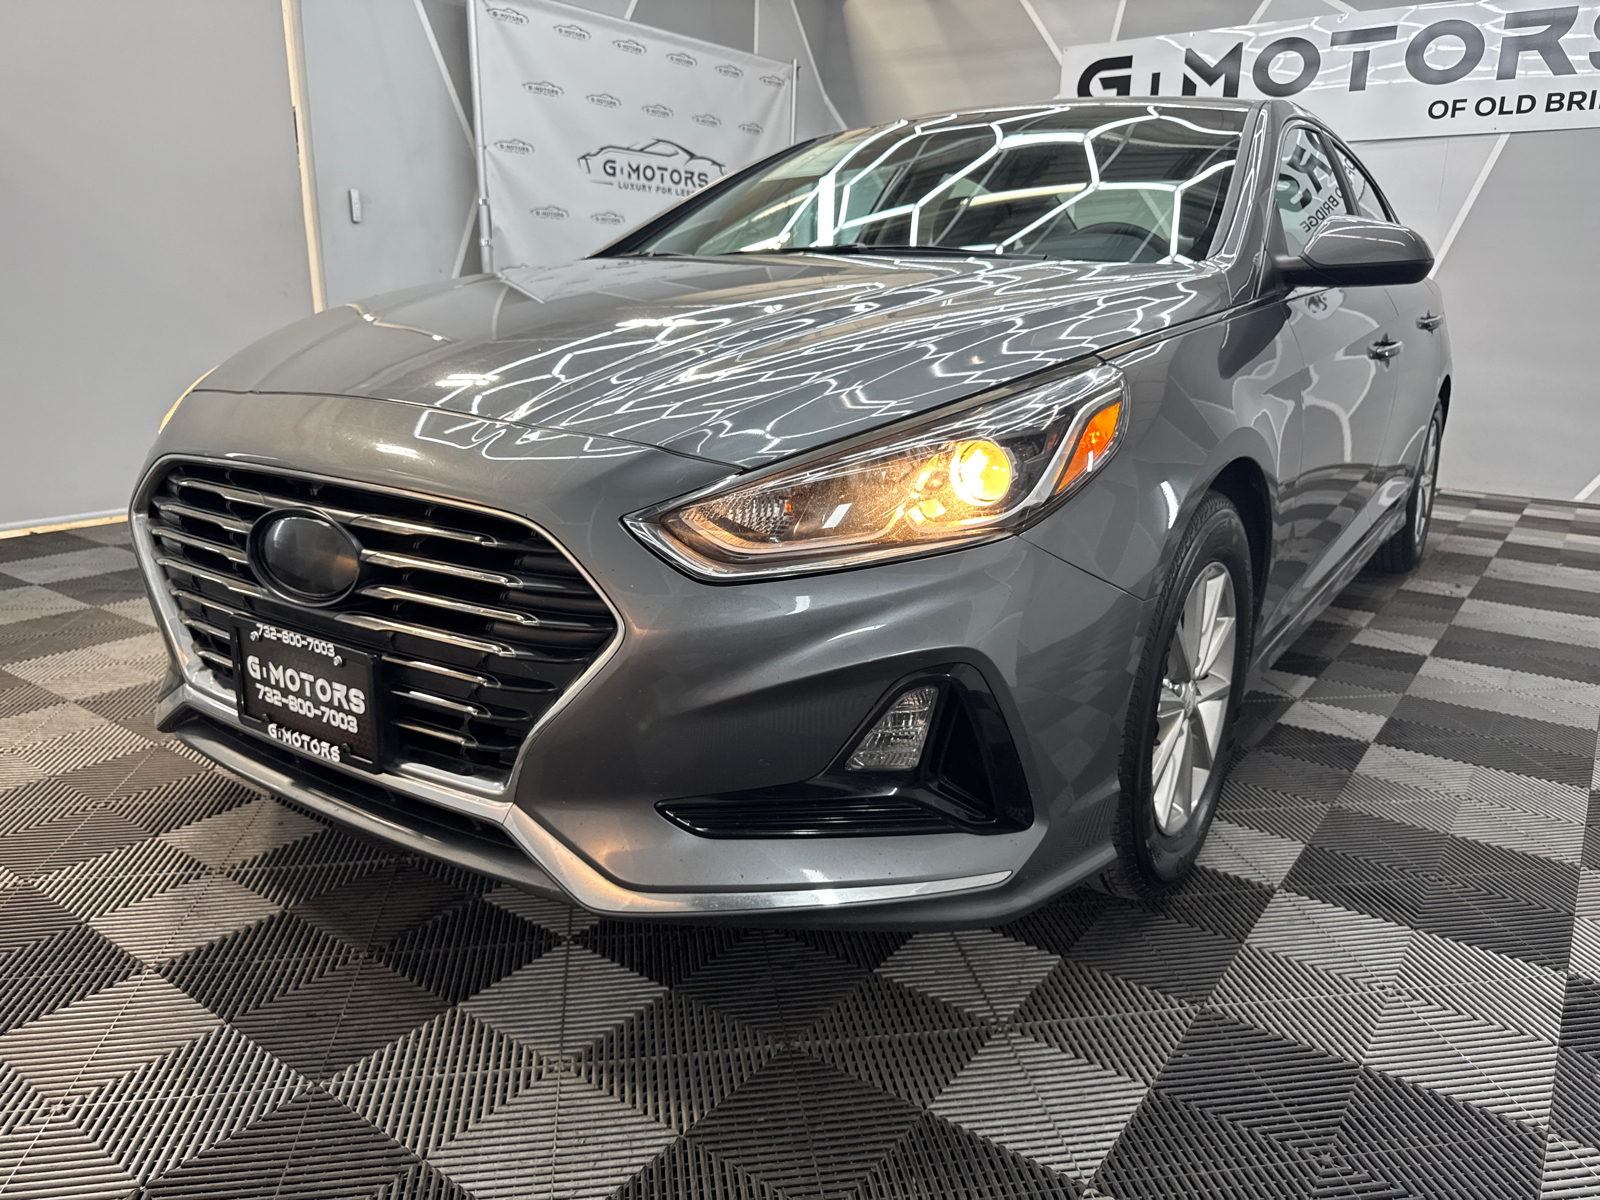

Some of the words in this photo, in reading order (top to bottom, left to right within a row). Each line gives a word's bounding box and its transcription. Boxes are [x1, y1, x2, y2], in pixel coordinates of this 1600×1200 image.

[1428, 99, 1468, 120] OF
[1475, 94, 1537, 118] OLD
[1545, 89, 1600, 113] BRI
[617, 181, 653, 194] LUXURY
[656, 186, 673, 196] FOR
[256, 623, 336, 658] 732-800-7003
[255, 682, 359, 734] 732-800-7003
